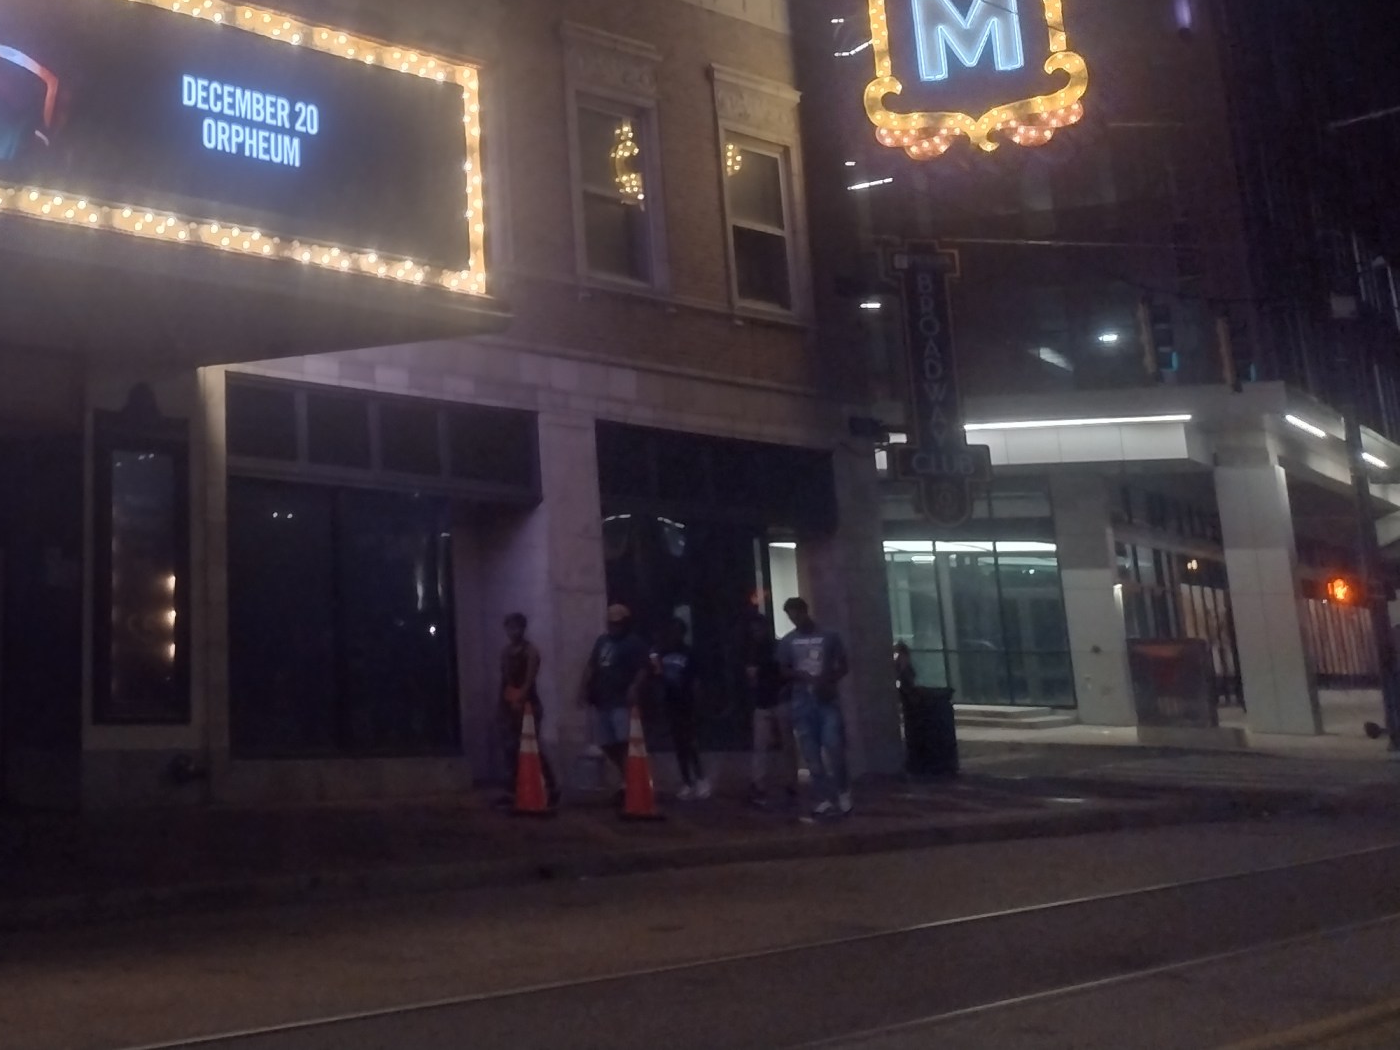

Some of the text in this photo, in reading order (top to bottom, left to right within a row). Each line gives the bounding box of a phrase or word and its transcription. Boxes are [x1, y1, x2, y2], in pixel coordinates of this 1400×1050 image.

[182, 73, 320, 136] DECEMBER 20
[202, 116, 301, 168] ORPHEUM
[915, 272, 949, 448] BROADWAY
[911, 452, 976, 476] CLUB
